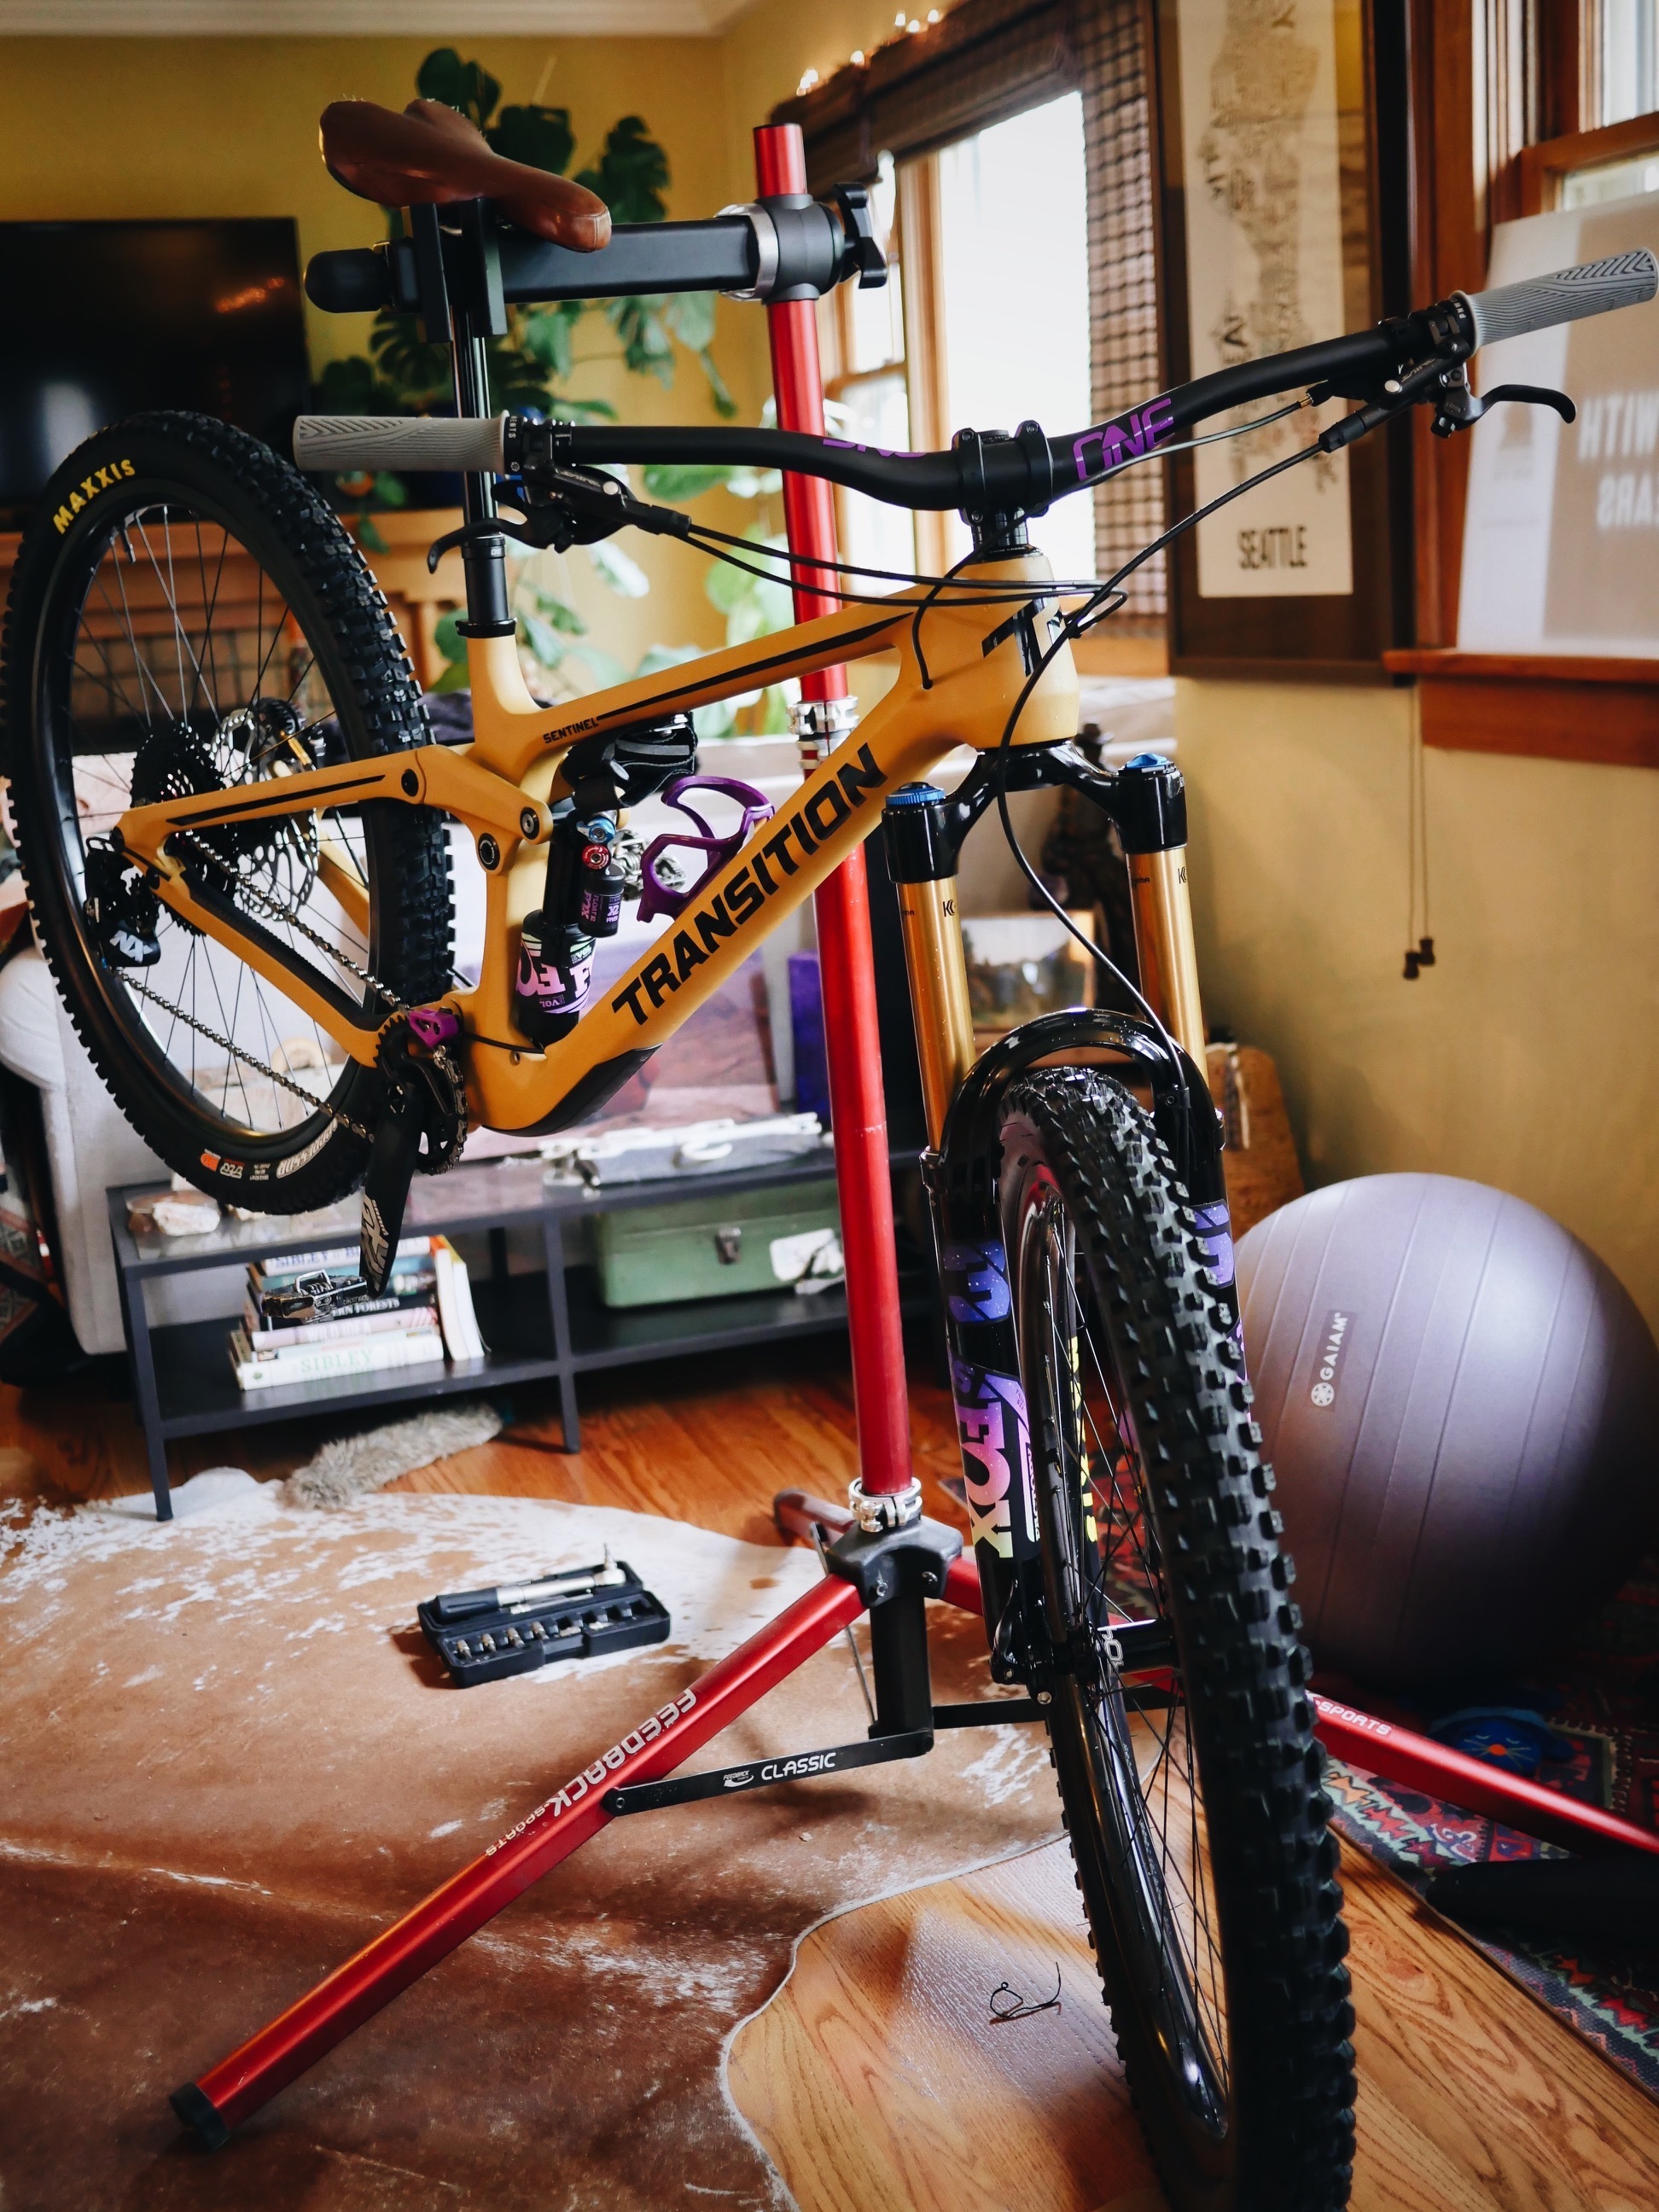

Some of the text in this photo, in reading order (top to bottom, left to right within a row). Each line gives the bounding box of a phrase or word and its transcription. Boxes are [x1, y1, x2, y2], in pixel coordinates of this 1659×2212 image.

[53, 459, 136, 535] MAXXIS
[1237, 525, 1307, 570] SEATTLE
[543, 718, 599, 744] SENTINEL
[611, 742, 888, 1026] TRANSITION
[274, 1249, 329, 1270] SIBLEY
[356, 1296, 400, 1315] FORESTS
[300, 1348, 373, 1375] SIBLEY
[1320, 1314, 1348, 1381] GAIAM
[1319, 1699, 1394, 1737] SPORTS
[486, 1688, 698, 1856] FEEDBACK SPORTS
[760, 1752, 836, 1782] CLASSIC
